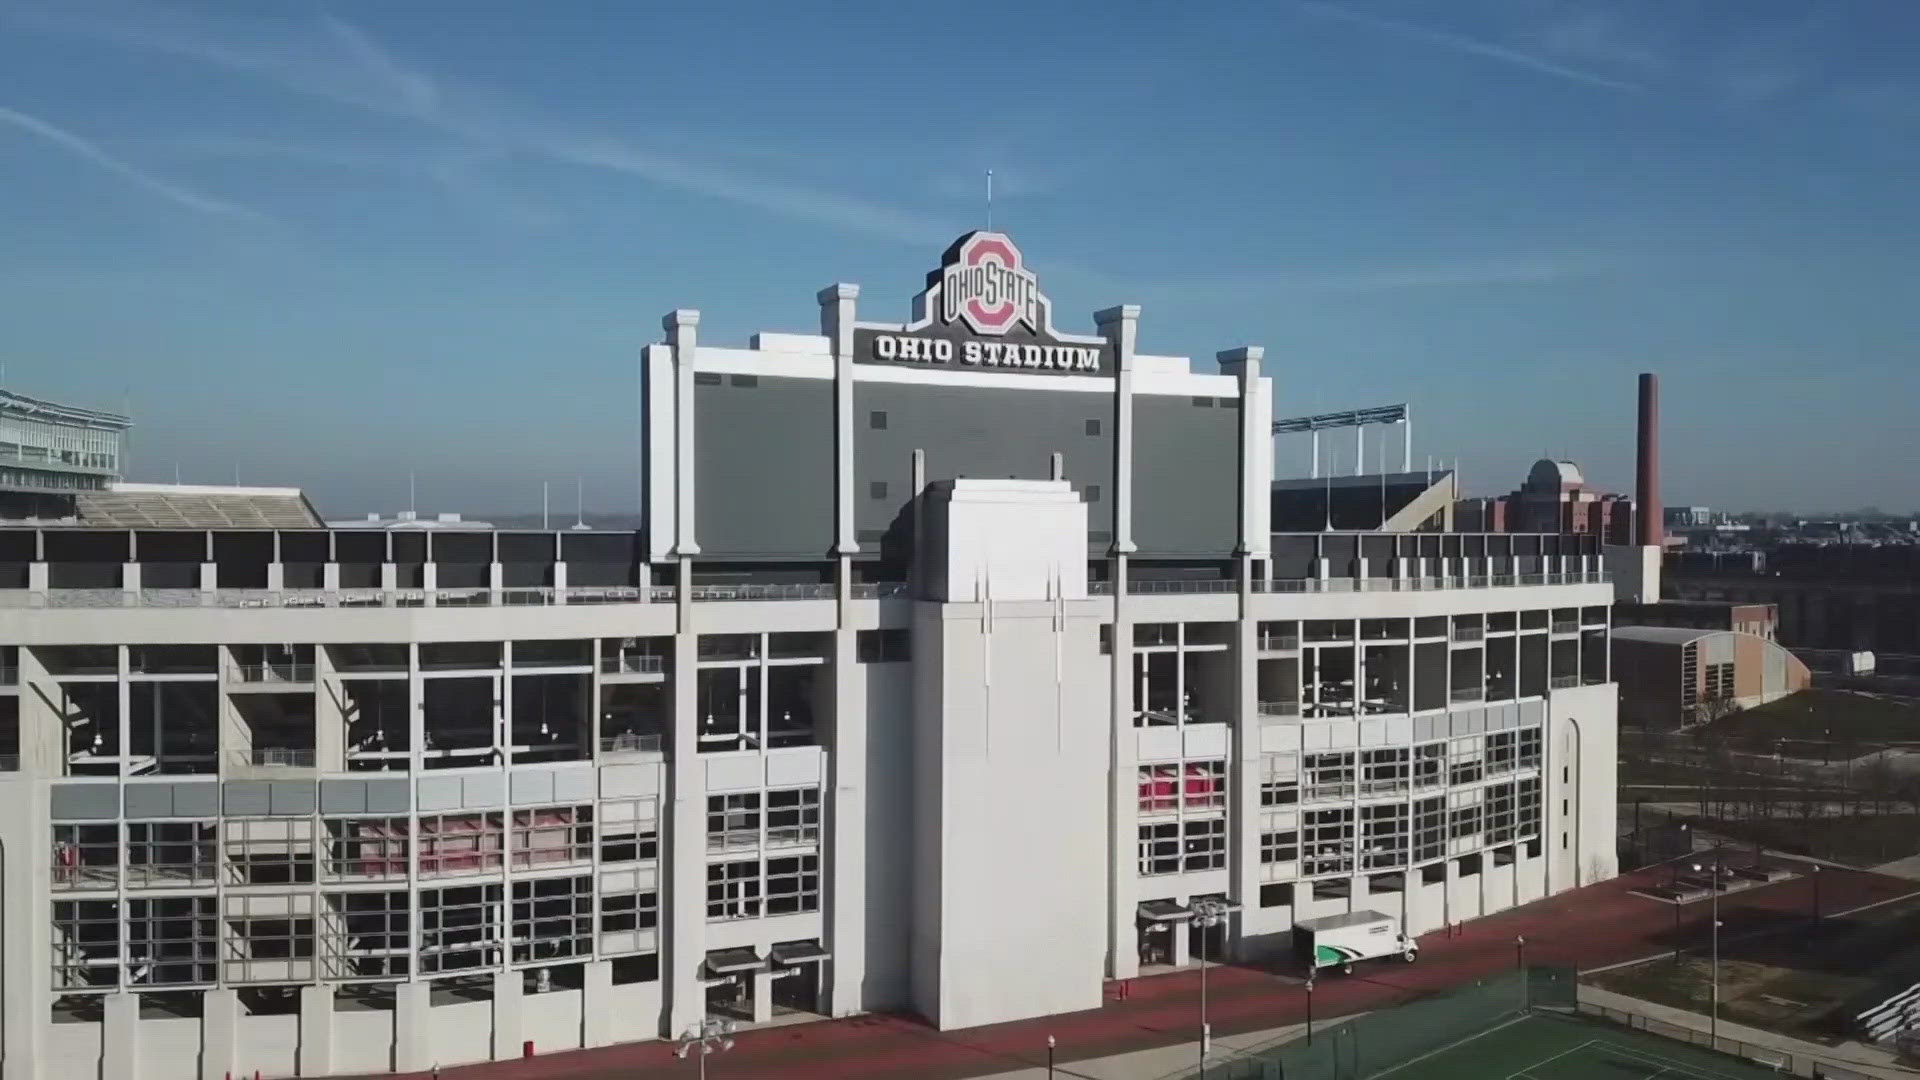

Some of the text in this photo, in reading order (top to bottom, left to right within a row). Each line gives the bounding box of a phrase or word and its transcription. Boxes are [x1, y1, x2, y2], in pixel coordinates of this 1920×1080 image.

[947, 261, 1034, 322] OHIO STATE
[875, 335, 1101, 372] OHIO STADIUM
